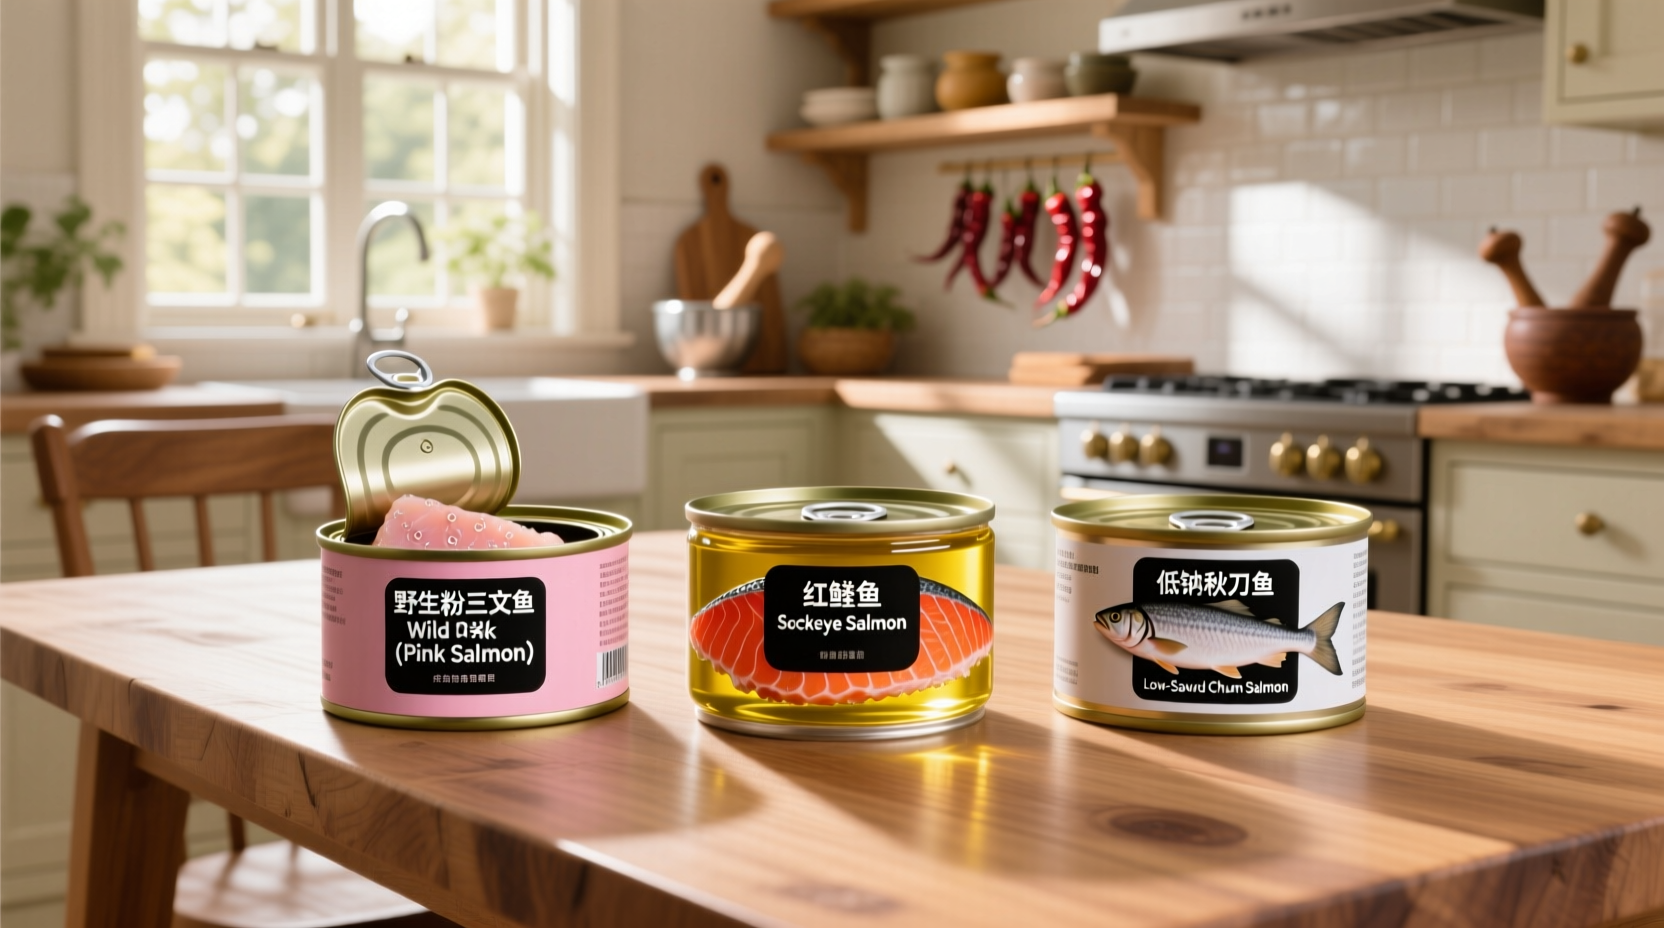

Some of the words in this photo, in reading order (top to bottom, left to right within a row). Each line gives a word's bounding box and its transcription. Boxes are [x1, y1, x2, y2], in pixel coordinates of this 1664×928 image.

[393, 588, 535, 617] 野生粉三文鱼
[406, 619, 450, 640] Wild
[777, 613, 843, 637] Sockeye
[845, 613, 907, 631] Salmon
[395, 640, 446, 667] (Pink
[450, 639, 534, 666] Salmon)
[1245, 680, 1289, 694] Salmon
